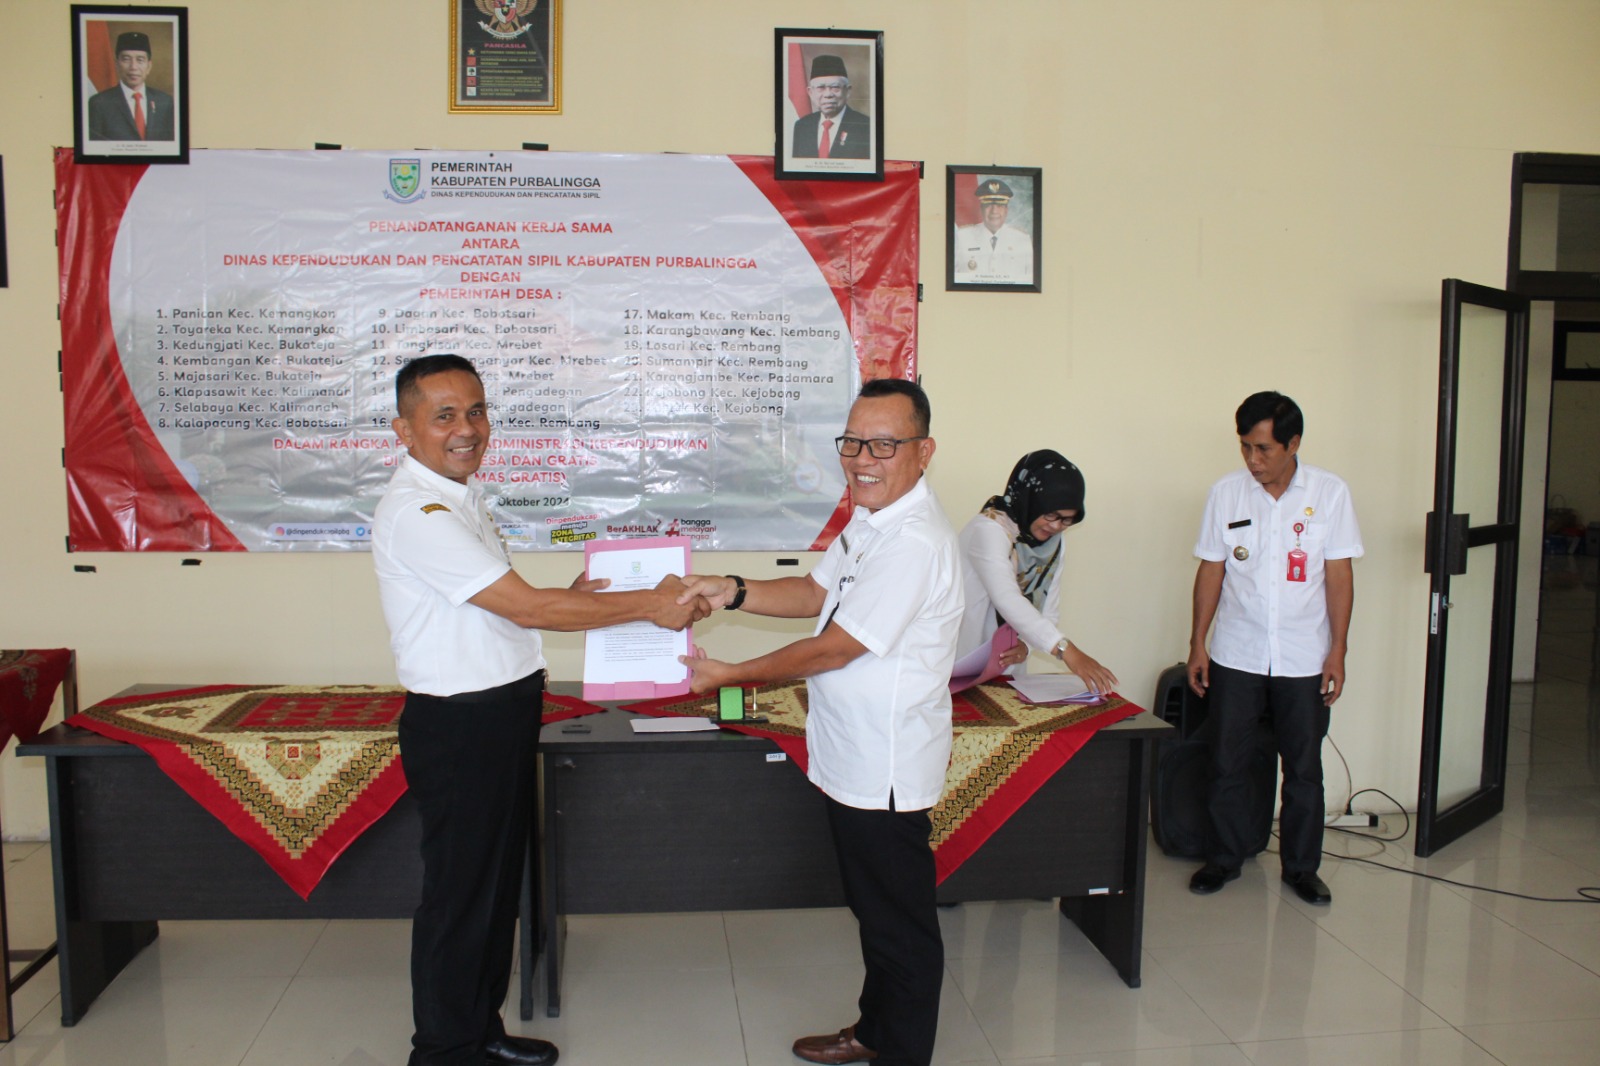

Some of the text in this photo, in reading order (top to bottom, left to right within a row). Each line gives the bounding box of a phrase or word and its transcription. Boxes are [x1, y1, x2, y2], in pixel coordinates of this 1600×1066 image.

[431, 162, 513, 173] PEMERINTAH
[431, 176, 601, 188] KABUPATEN PURBALINGGA
[369, 221, 613, 234] PENANDATANGANAN KERJA SAMA
[461, 238, 520, 249] ANTARA
[223, 255, 758, 269] DINAS KEPENDUDUKAN DAN PENCATATAN SIPIL KABUPATEN PURBALINGGA
[460, 272, 521, 283] DENGAN
[419, 288, 511, 300] PEMERINTAH
[515, 288, 553, 299] DESA
[156, 309, 336, 321] 1. Panican Kec. Kemangkon
[473, 308, 536, 319] Bobotsari
[623, 309, 790, 323] 17. Makam Kec. Rembang
[156, 324, 344, 337] 2. Toyareka Kec. Kemangkon
[371, 323, 557, 334] 10. Limbasari Kec. Bobotsari
[623, 325, 841, 340] 18. Karangbawang Kec. Rembang
[157, 339, 335, 352] 3. Kedungjati Kec. Bukateja
[465, 340, 492, 350] Kec.
[497, 340, 542, 350] Mrebet
[623, 340, 781, 354] 19. Losari Kec. Rembang
[157, 355, 343, 368] 4. Kembangan Kec. Bukateja
[371, 356, 390, 366] 12.
[528, 356, 555, 366] Kec.
[560, 356, 607, 366] Mrebet
[646, 356, 713, 369] Sumampir
[717, 357, 744, 367] Kec.
[748, 357, 809, 370] Rembang
[158, 371, 322, 383] 5. Majasari Kec. Bukateja
[508, 371, 555, 381] Mrebet
[646, 372, 733, 384] Karangjambe
[737, 372, 763, 383] Kec.
[769, 373, 834, 384] Padamara
[158, 387, 170, 397] 6.
[174, 386, 247, 399] Klapasawit
[251, 387, 277, 397] Kec.
[503, 387, 582, 399] Pengadegan
[710, 388, 737, 398] Kec.
[741, 388, 801, 400] Kejobong
[159, 402, 339, 414] 7. Selabaya Kec. Kalimanah
[693, 403, 720, 413] Kec.
[725, 403, 784, 416] Kejobong
[158, 417, 348, 429] 8. Kalapacung Kec. Bobotsari
[371, 417, 391, 428] 16.
[508, 418, 535, 428] Kec.
[540, 418, 600, 430] Rembang
[273, 438, 324, 449] DALAM
[329, 438, 390, 449] RANGKA
[589, 439, 708, 451] KEPENDUDUKAN
[384, 455, 599, 467] DI ESA DAN GRATIS
[509, 471, 567, 485] GRATIS)
[498, 496, 541, 507] Oktober
[681, 518, 711, 527] bangga
[551, 529, 573, 538] ZONA
[606, 525, 659, 533] BerAKHLAK
[681, 525, 717, 534] melayani
[551, 532, 597, 545] INTEGRITAS
